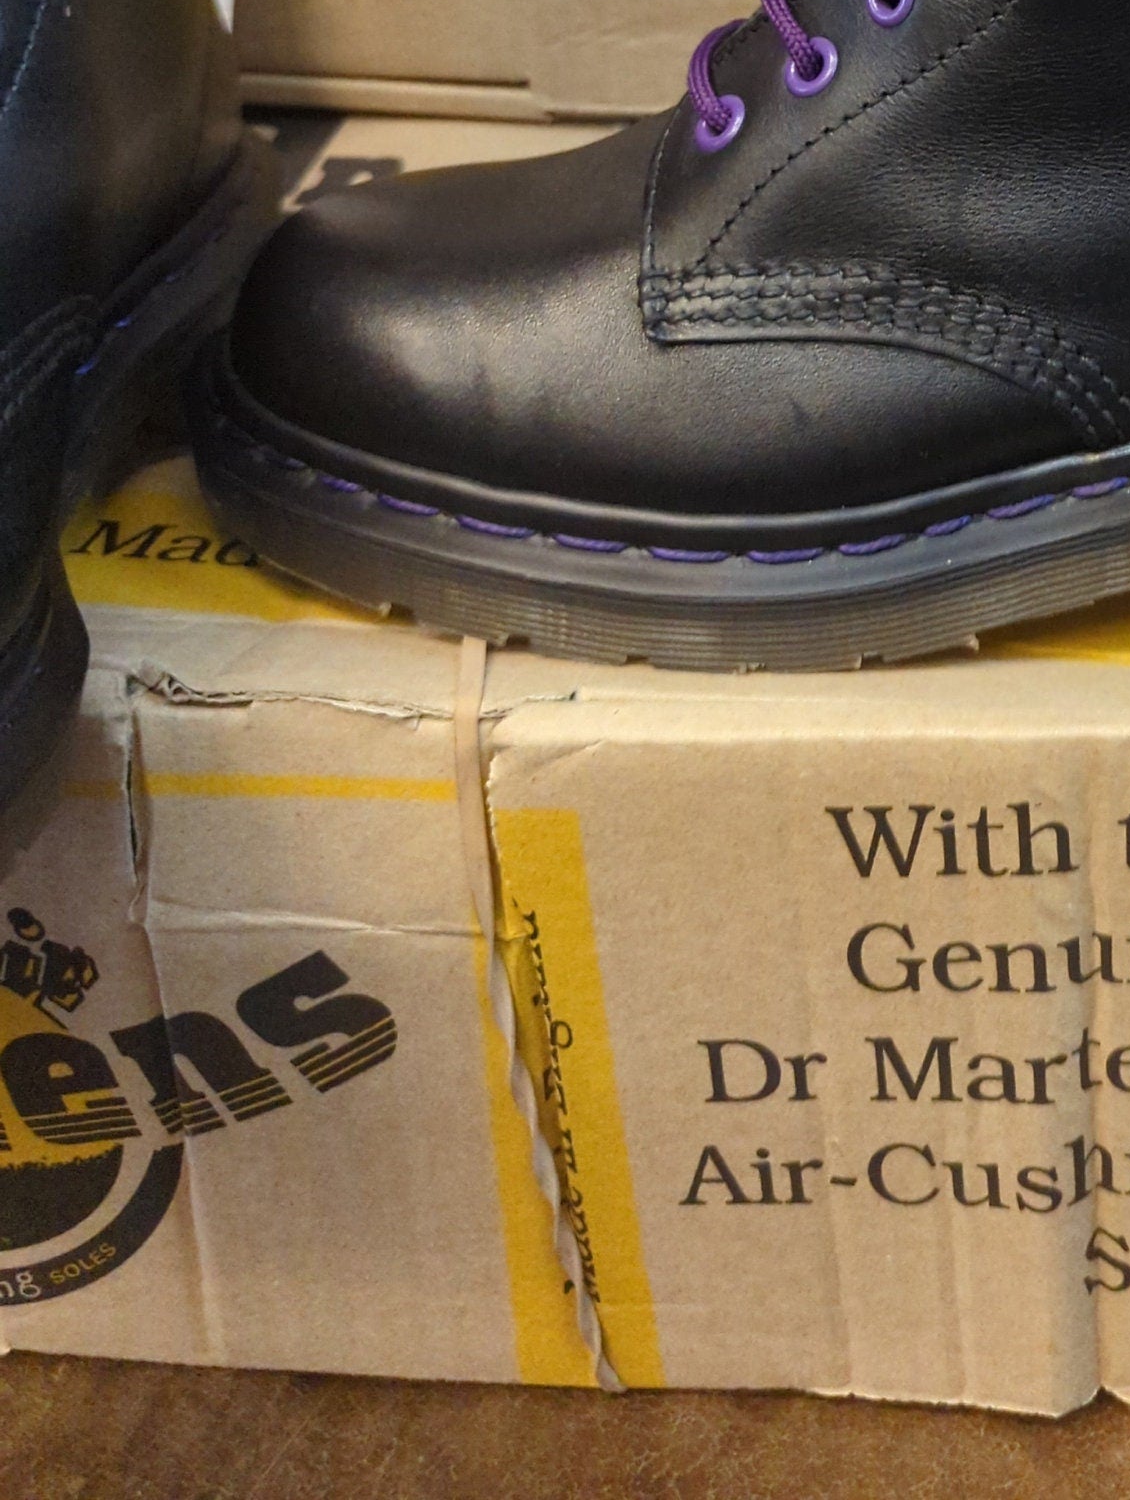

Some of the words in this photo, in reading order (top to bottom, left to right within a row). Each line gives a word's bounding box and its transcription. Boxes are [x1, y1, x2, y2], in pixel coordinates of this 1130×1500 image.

[824, 801, 1081, 878] With
[697, 1038, 828, 1103] Dr
[49, 1242, 118, 1285] SOLES
